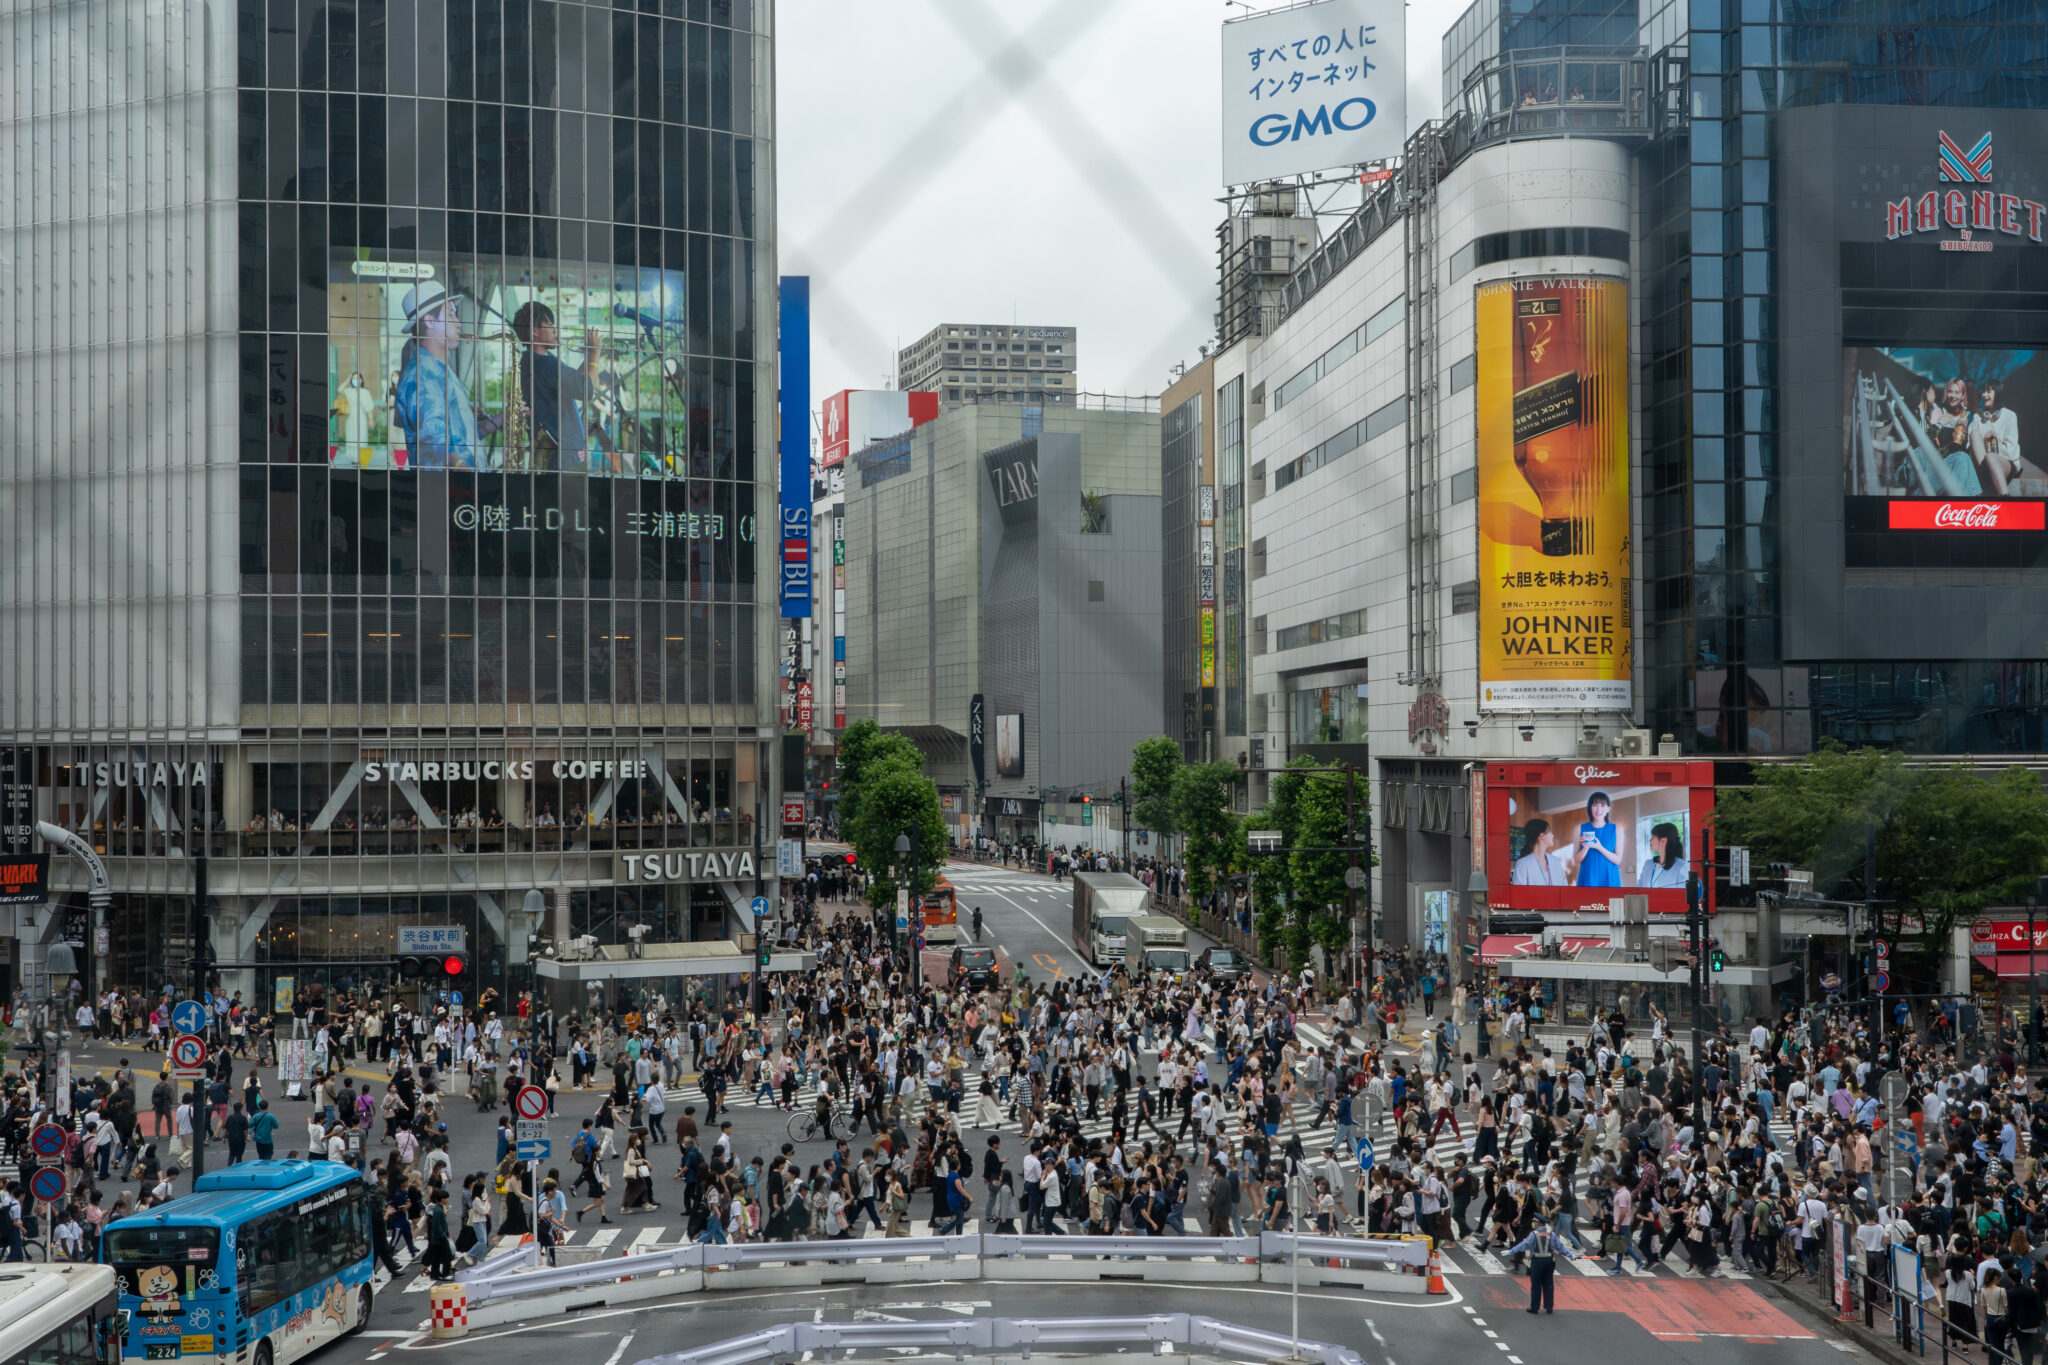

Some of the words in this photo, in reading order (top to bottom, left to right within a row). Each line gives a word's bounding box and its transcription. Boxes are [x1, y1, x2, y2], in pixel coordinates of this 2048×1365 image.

[1248, 25, 1376, 71] すべての人に
[1248, 56, 1377, 100] インターネット
[1248, 97, 1377, 147] GMO
[1362, 171, 1376, 182] MEDIA
[1376, 170, 1390, 180] DEPT.
[1885, 190, 2047, 242] MAGNET
[1961, 229, 1972, 240] by
[1941, 240, 1993, 252] SHIBUYA109
[1477, 279, 1534, 301] JOHNNIE
[1542, 278, 1604, 291] WALKER
[1541, 397, 1574, 415] BLACK
[992, 461, 1038, 507] ZARA
[1934, 503, 2001, 527] Coca-Cola
[784, 507, 809, 600] SEIBU
[1201, 541, 1212, 562] 内科
[1201, 568, 1213, 599] 処方せん
[1501, 570, 1614, 588] 大胆を味わおう。
[1501, 615, 1614, 635] JOHNNIE
[1501, 636, 1614, 656] WALKER
[972, 702, 983, 745] ZARA
[77, 761, 206, 787] TSUTAYA
[364, 760, 534, 782] STARBUCKS
[552, 760, 648, 779] COFFEE
[1574, 766, 1620, 784] Glico
[3, 783, 33, 791] TSUAYA
[786, 805, 801, 821] 本
[1002, 799, 1022, 815] ZARA
[3, 824, 32, 836] WIED
[622, 851, 756, 881] TSUTAYA
[403, 930, 460, 943] 渋谷駅前
[1990, 932, 2010, 941] INZA
[412, 943, 438, 951] Shibuya
[440, 943, 454, 951] Sta.
[139, 1324, 182, 1336] ハチ公バス
